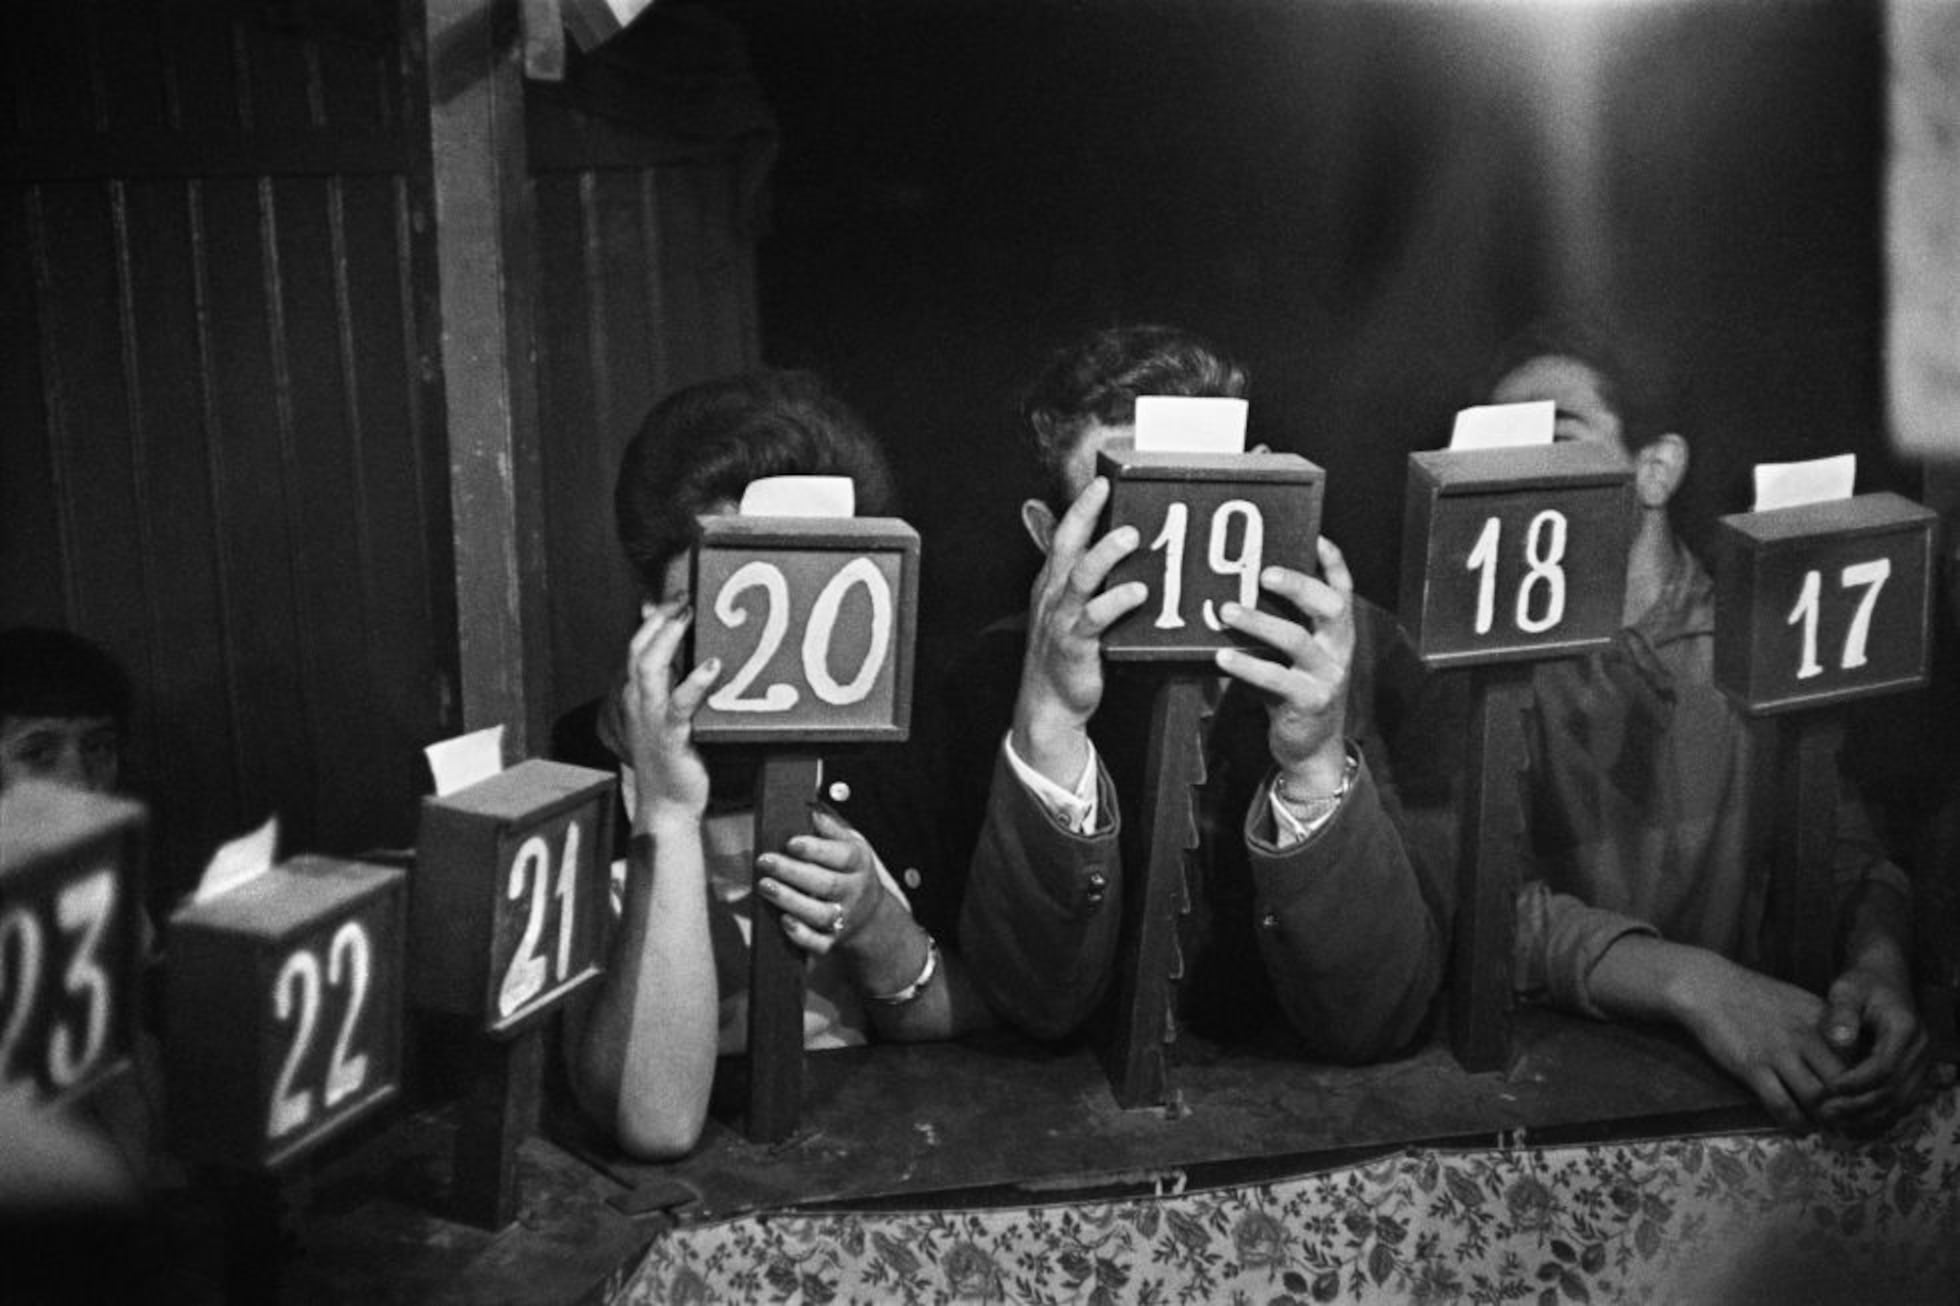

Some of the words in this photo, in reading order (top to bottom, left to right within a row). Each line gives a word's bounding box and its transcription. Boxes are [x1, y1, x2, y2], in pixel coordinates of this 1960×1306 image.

[707, 557, 892, 712] 20
[1151, 499, 1264, 632] 19
[1466, 509, 1568, 635] 18
[1787, 558, 1891, 680] 17
[0, 868, 117, 1097] 23
[499, 820, 580, 1018] 21
[266, 921, 370, 1139] 22
